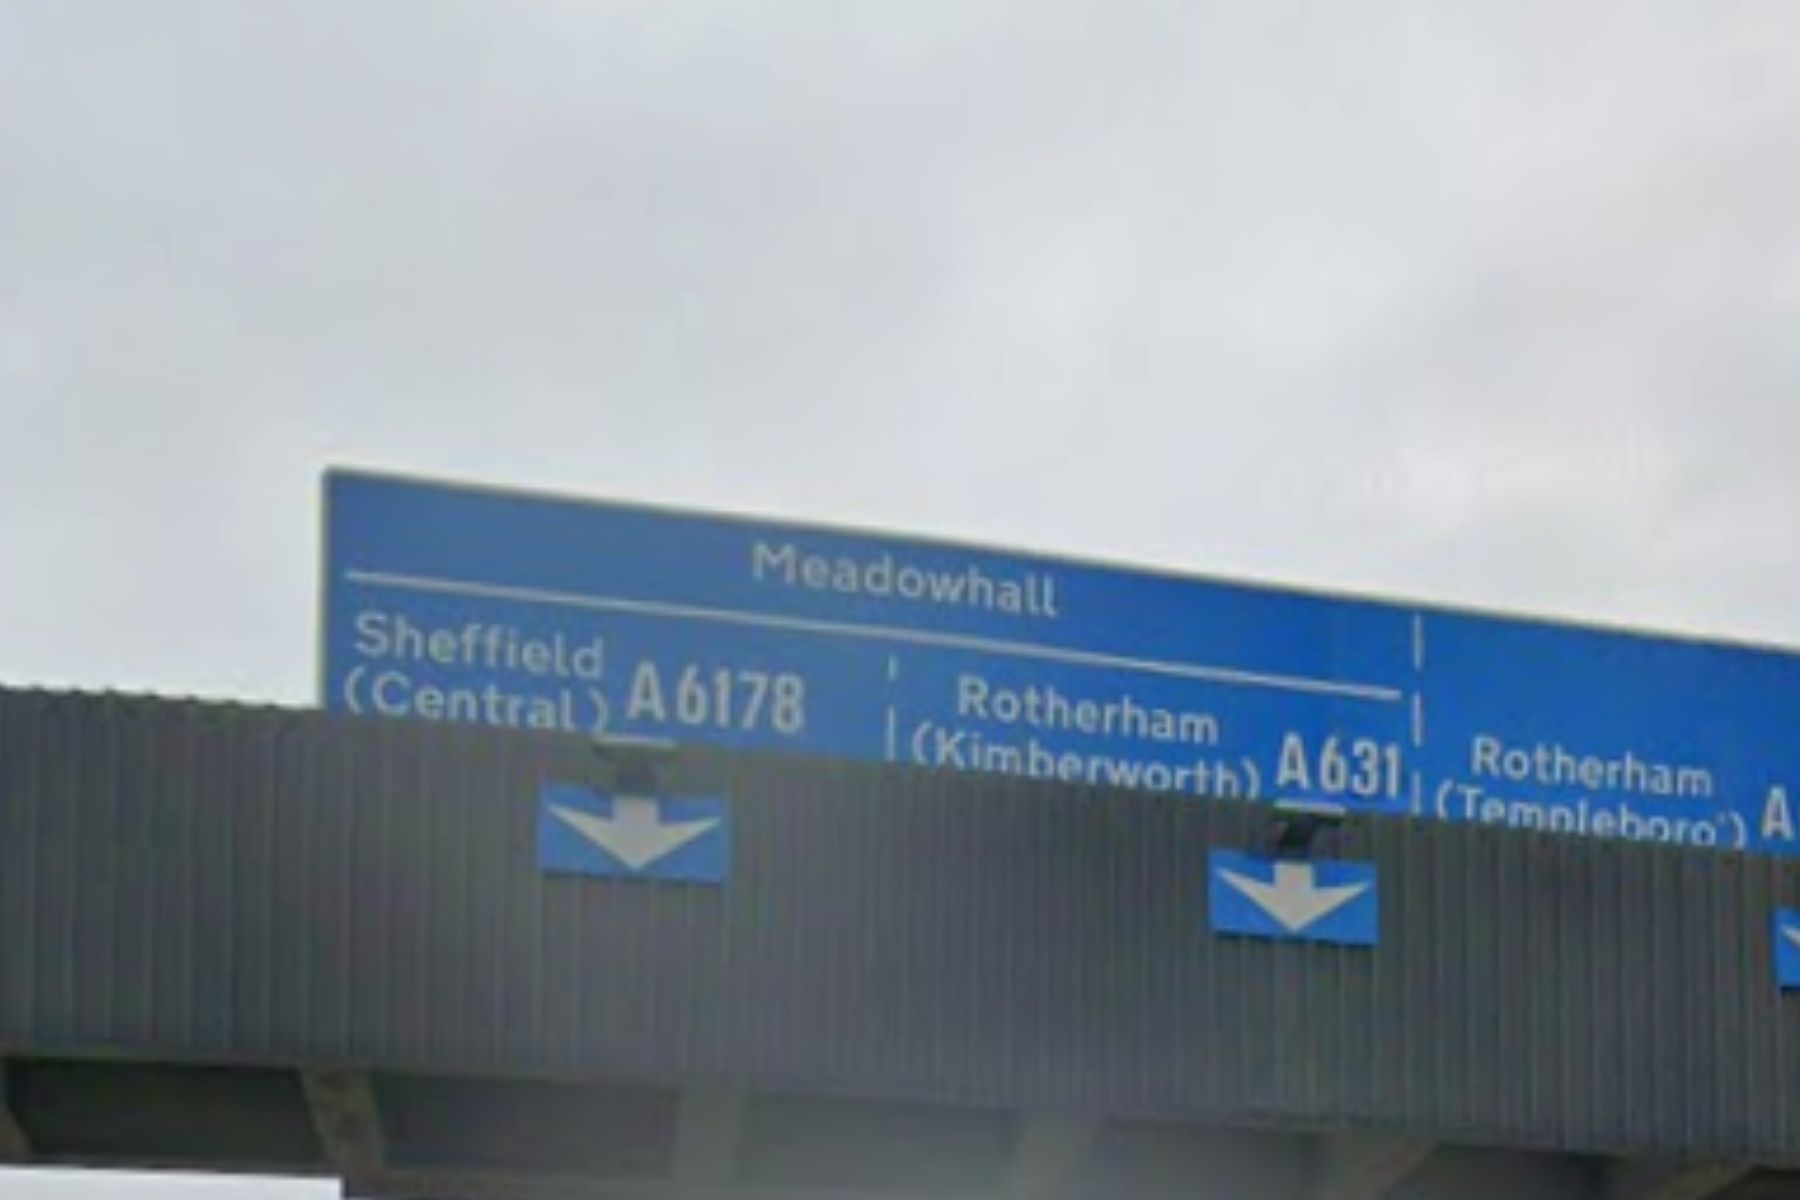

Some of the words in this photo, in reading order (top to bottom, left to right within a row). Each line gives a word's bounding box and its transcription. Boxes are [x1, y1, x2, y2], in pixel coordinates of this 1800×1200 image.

[752, 541, 1058, 617] Meadowhall
[353, 609, 604, 678] Sheffield
[344, 665, 608, 732] (Central)
[627, 660, 806, 734] A6178
[957, 673, 1219, 745] Rotherham
[911, 721, 1261, 800] (Kimberworth)
[1276, 731, 1400, 798] A631
[1471, 734, 1713, 798] Rotherham
